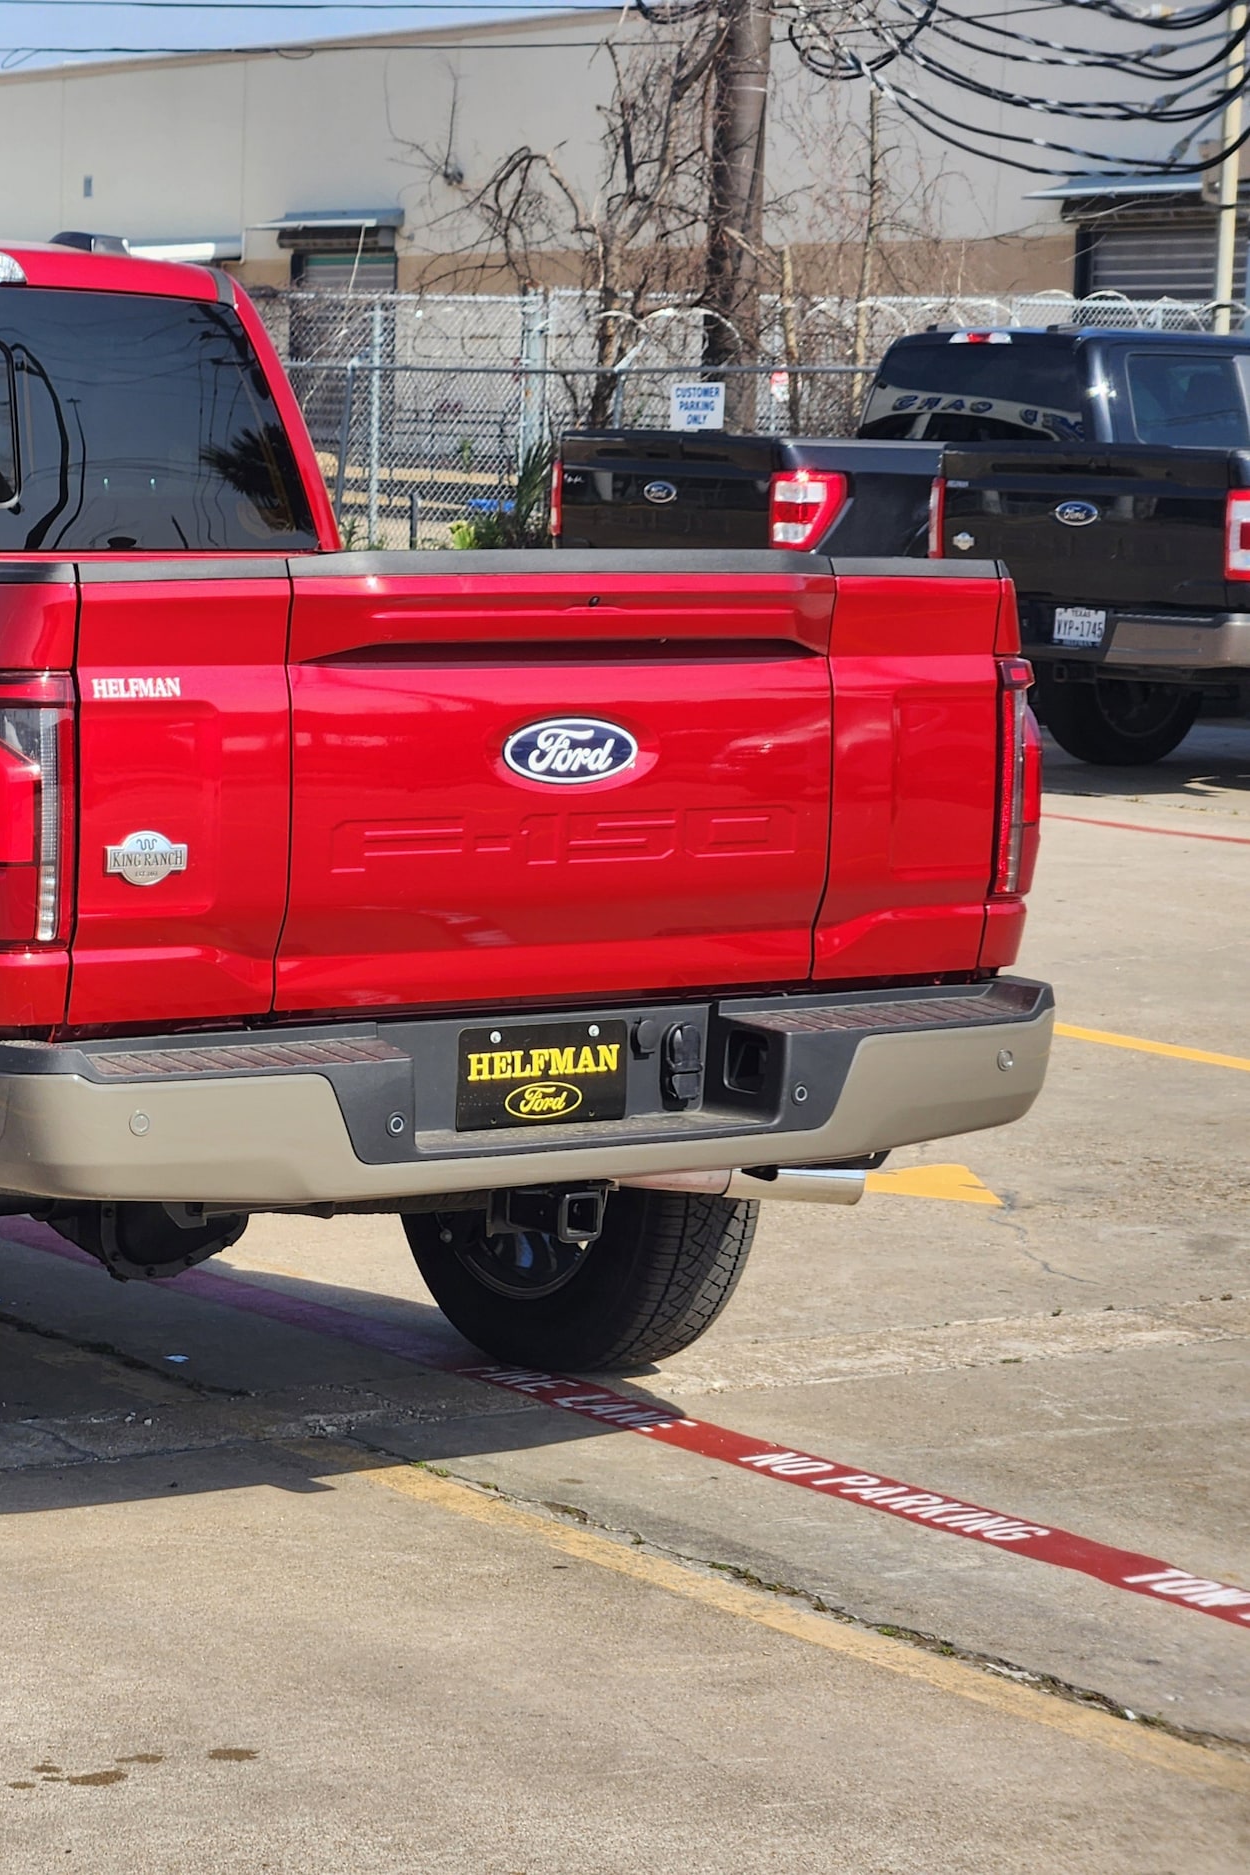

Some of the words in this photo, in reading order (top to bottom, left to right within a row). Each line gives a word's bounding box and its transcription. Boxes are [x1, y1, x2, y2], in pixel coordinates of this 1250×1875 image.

[675, 387, 720, 398] CUSTOMER
[679, 401, 715, 412] PARKING
[686, 414, 708, 425] ONLY
[92, 677, 181, 698] HELFMAN
[528, 728, 615, 772] Ford
[330, 805, 796, 873] F-150
[112, 852, 142, 867] KING
[144, 850, 183, 866] RANCH
[467, 1043, 621, 1082] HELFMAN
[518, 1086, 568, 1114] Ford
[739, 1452, 835, 1475] NO
[811, 1475, 1051, 1541] PARKING
